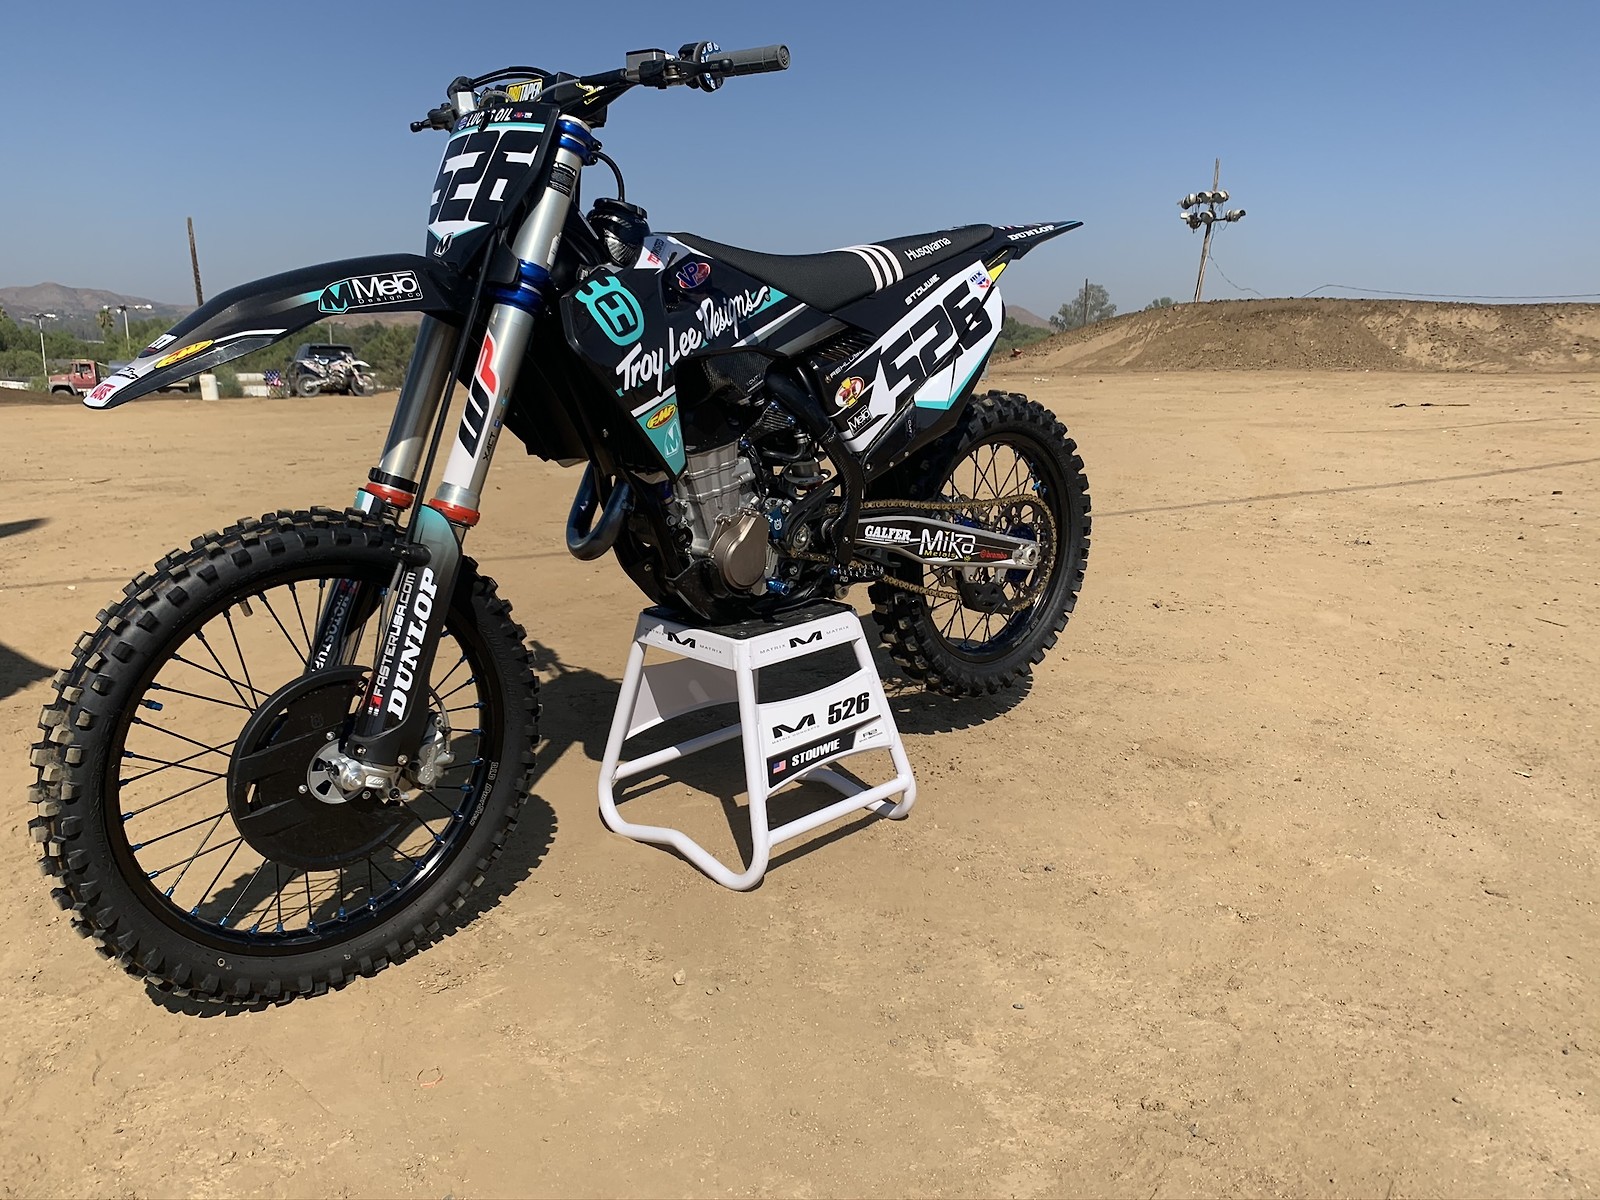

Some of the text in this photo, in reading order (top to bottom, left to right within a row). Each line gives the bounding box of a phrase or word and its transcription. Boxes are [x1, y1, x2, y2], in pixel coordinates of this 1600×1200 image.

[466, 109, 496, 127] LUCS
[494, 108, 513, 122] OIL
[1007, 225, 1055, 241] DUNLOP
[904, 237, 951, 261] Husqvarna
[358, 294, 402, 304] Design
[905, 274, 940, 305] STOUWIE
[616, 285, 770, 393] Troy Lee Designs
[881, 280, 993, 391] 526
[649, 405, 676, 427] FMF
[864, 525, 911, 541] GALFER
[919, 528, 976, 558] Mika
[923, 550, 957, 559] Metals
[387, 567, 438, 721] DUNLOP
[699, 644, 722, 654] MATRIX
[760, 644, 786, 654] MATRIX
[826, 625, 849, 634] MATRIX
[827, 692, 869, 725] 526
[791, 739, 840, 767] STOUWIE
